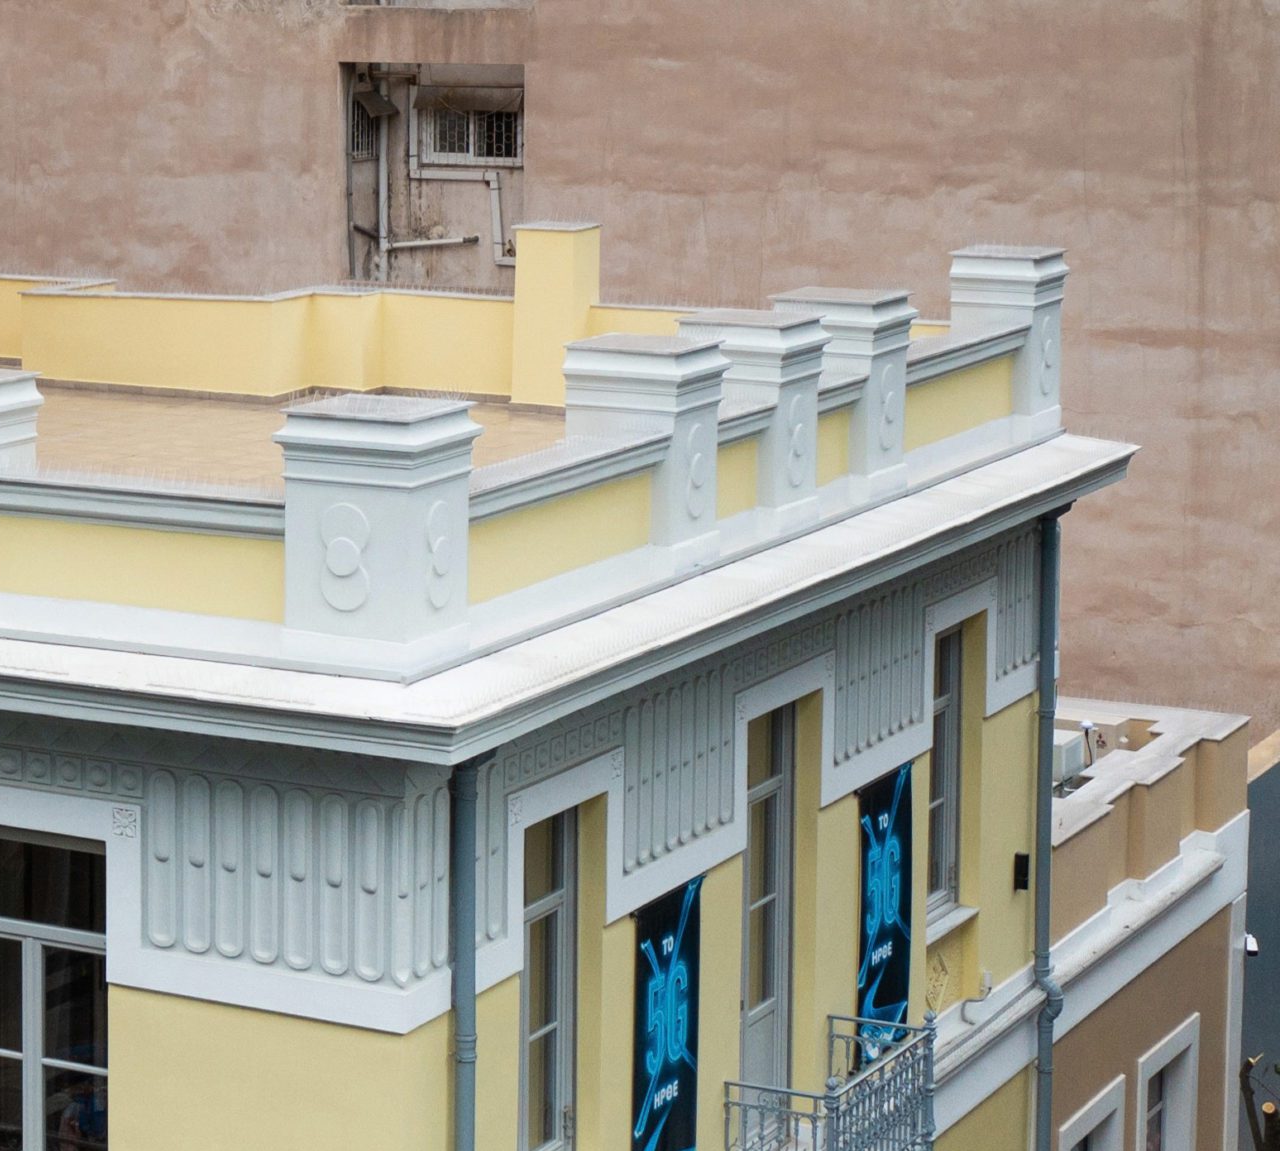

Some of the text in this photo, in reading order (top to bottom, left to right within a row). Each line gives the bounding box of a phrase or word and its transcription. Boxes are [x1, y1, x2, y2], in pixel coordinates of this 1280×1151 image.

[878, 813, 889, 830] ΤΟ
[866, 838, 900, 935] 5G
[662, 935, 674, 955] ΤΟ
[646, 961, 688, 1076] 5G
[653, 1079, 679, 1109] ΗΡΘΕ
